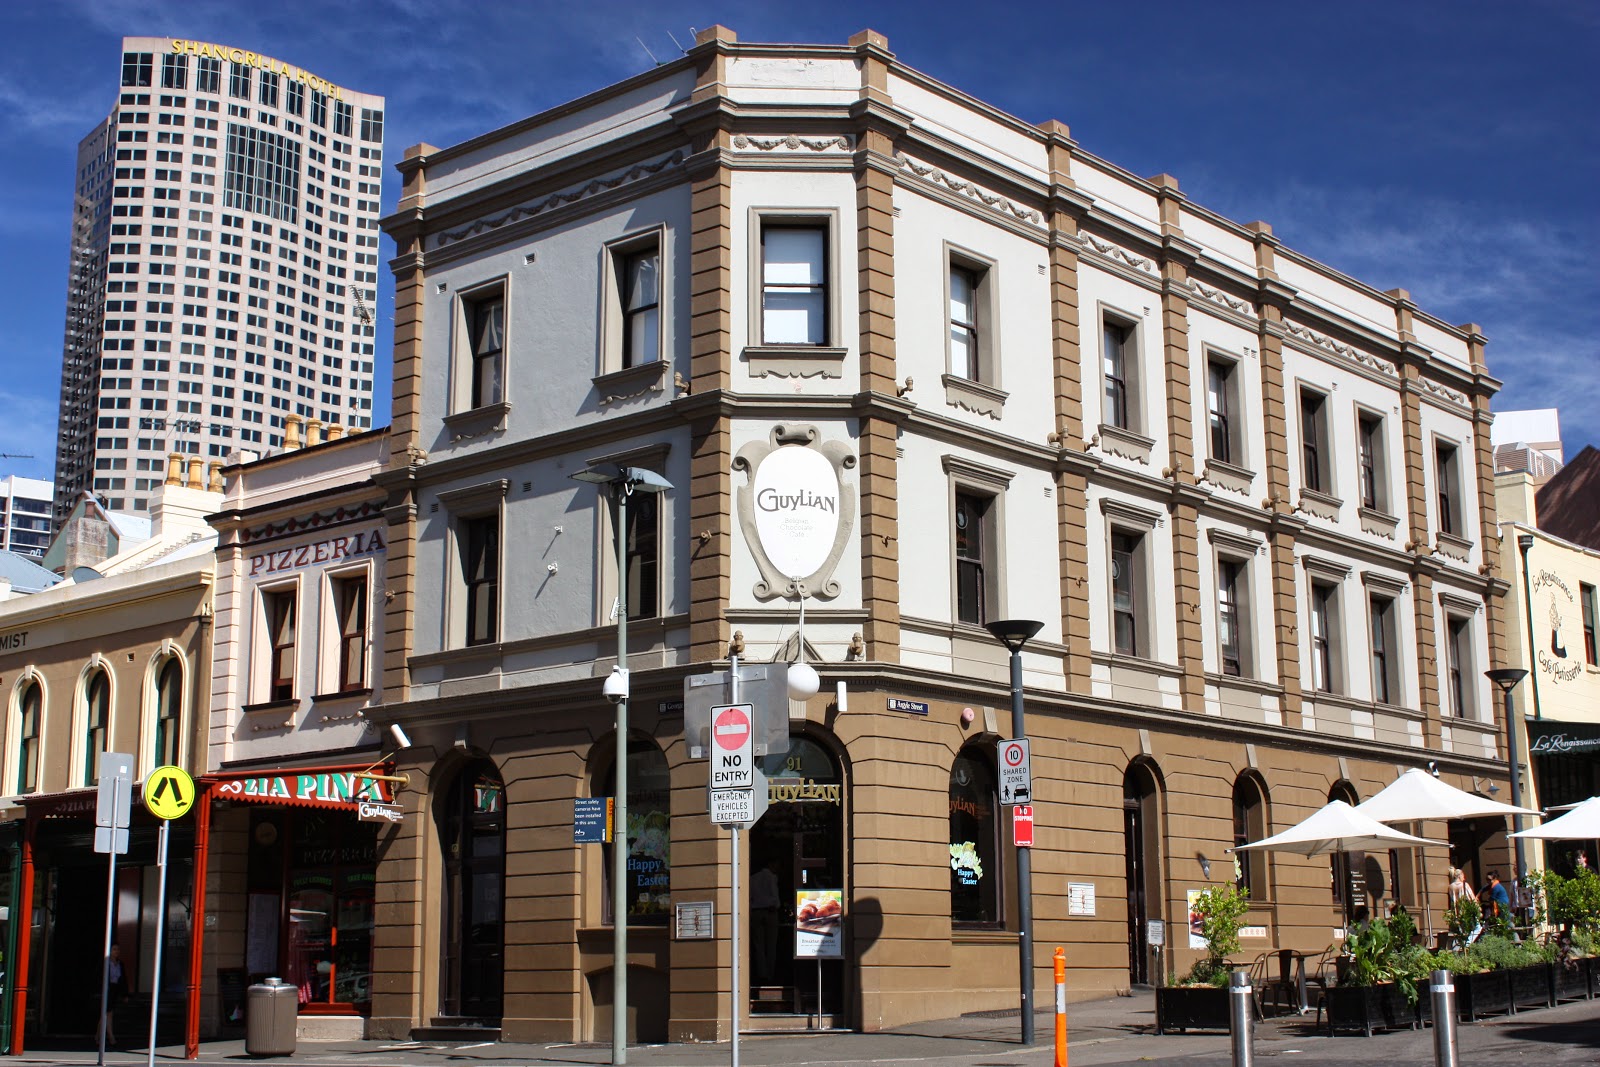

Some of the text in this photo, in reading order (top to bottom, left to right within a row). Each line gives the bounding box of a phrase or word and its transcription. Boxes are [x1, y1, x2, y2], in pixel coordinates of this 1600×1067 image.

[172, 40, 344, 101] SHANGRI-LA HOTEL
[249, 529, 386, 577] PIZZERIA
[1540, 569, 1574, 603] Renaissance
[897, 701, 924, 711] Argyle Street
[1530, 735, 1549, 751] La
[722, 755, 742, 768] NO
[1010, 750, 1019, 760] 10
[786, 756, 803, 771] 91
[715, 770, 749, 782] ENTRY
[1003, 767, 1027, 776] SHARED
[243, 772, 383, 803] ZIA PINA
[713, 792, 751, 802] EMERGENCY
[717, 801, 748, 811] VEHICLES
[716, 811, 749, 821] EXCEPTED
[627, 859, 662, 873] Happy
[957, 869, 974, 878] Happy
[637, 874, 669, 887] Easter
